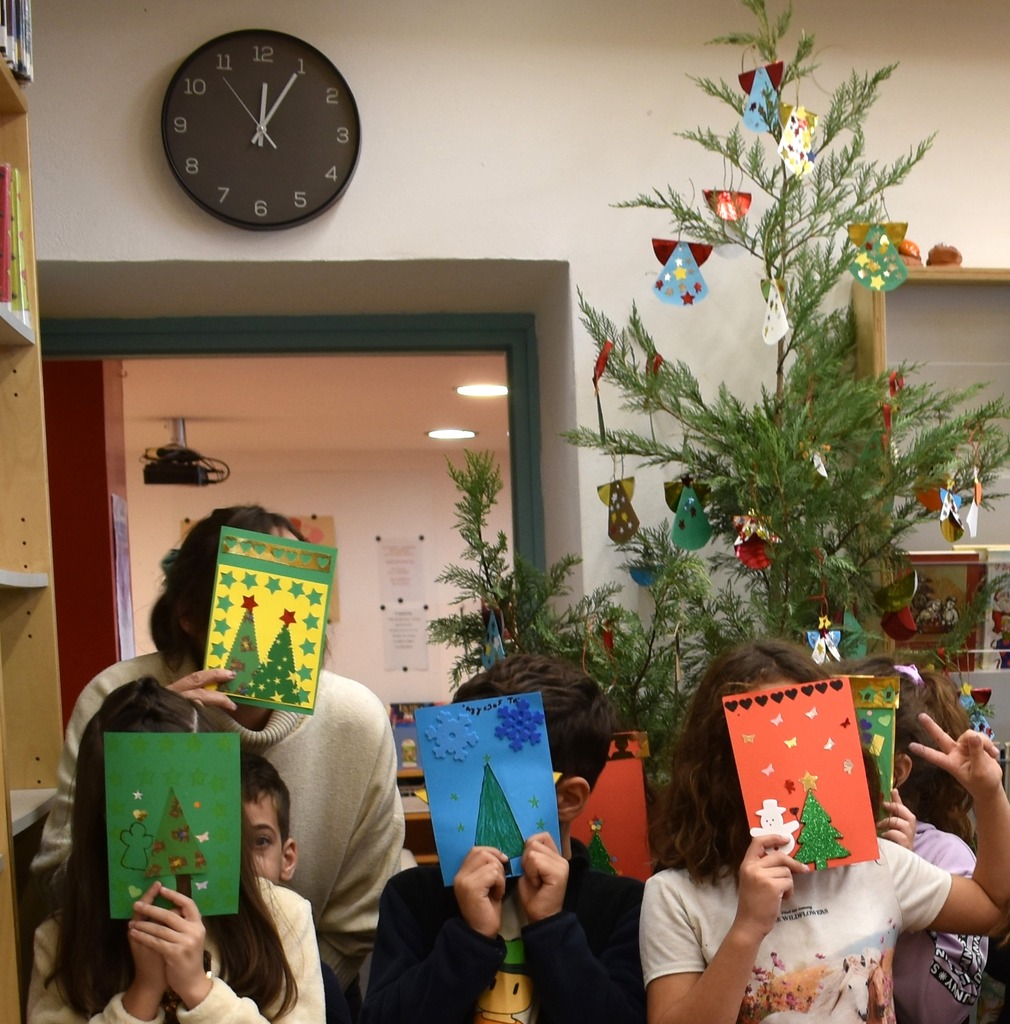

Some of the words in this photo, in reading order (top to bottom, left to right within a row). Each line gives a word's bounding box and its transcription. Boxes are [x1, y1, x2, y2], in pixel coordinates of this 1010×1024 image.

[216, 54, 232, 71] 11
[253, 46, 274, 63] 12
[298, 58, 306, 74] 1
[184, 78, 206, 95] 10
[326, 87, 339, 104] 2
[174, 116, 187, 133] 9
[336, 126, 349, 143] 3
[185, 157, 199, 174] 8
[325, 165, 338, 182] 4
[217, 186, 230, 203] 7
[294, 191, 307, 208] 5
[254, 200, 268, 217] 6
[781, 908, 829, 921] WILDFLOWERS
